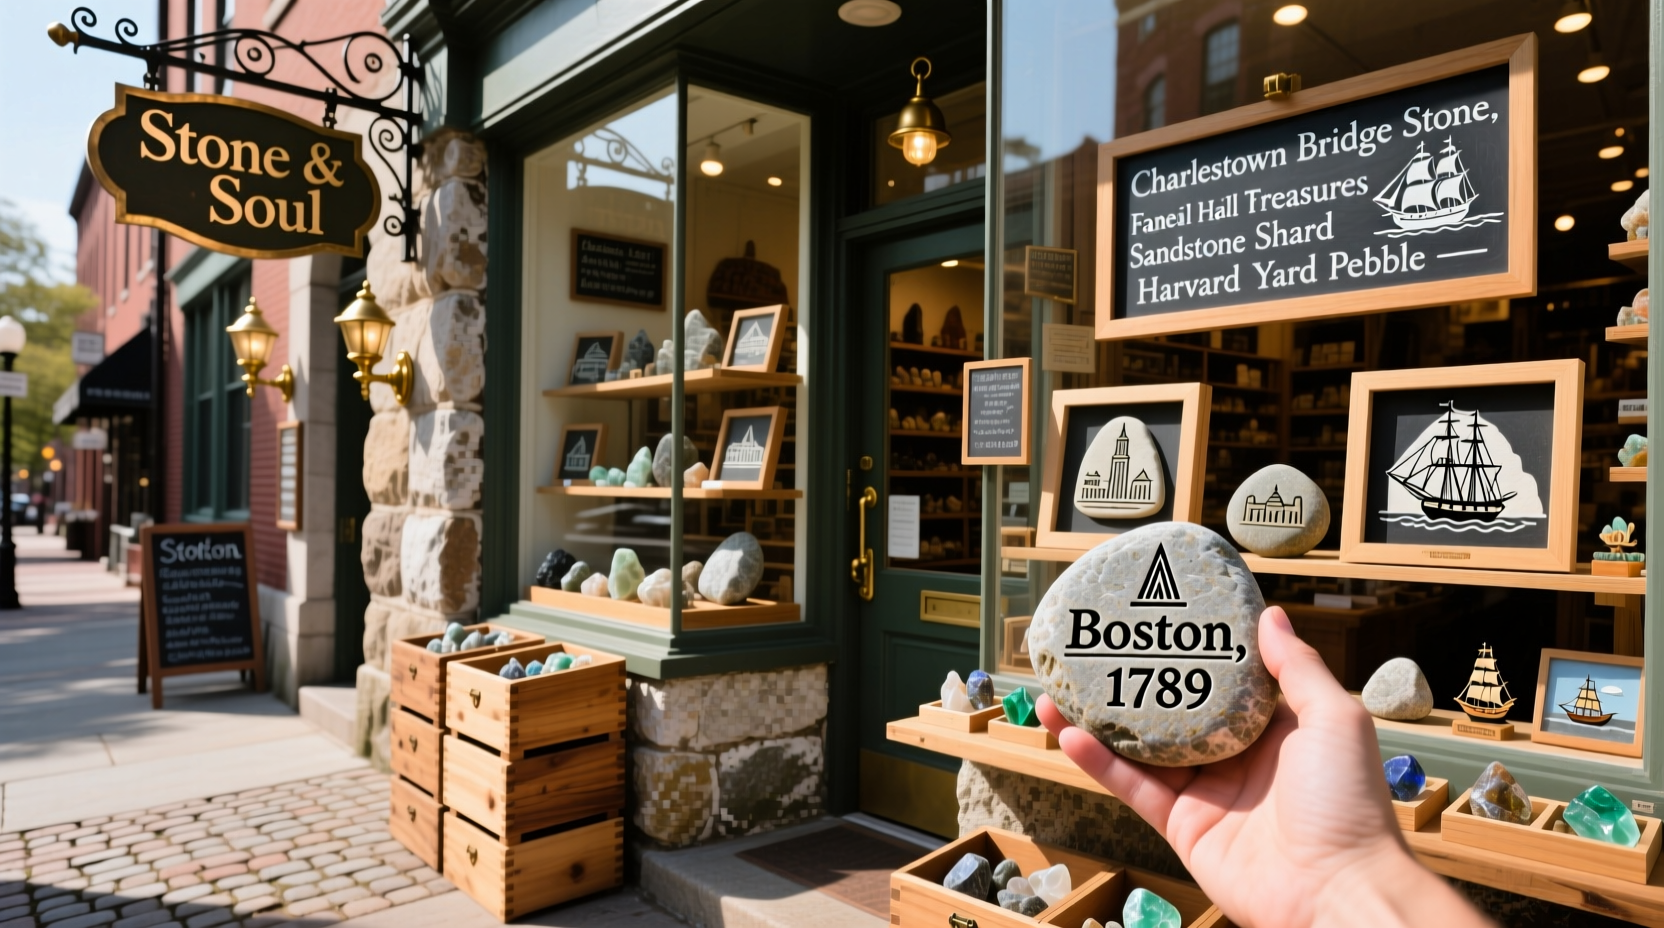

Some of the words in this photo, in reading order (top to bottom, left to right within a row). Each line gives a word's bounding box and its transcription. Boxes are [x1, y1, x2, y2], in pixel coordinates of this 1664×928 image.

[140, 108, 290, 178] Stone
[303, 142, 344, 187] &
[1130, 147, 1287, 199] Charlestown
[1297, 119, 1393, 163] Bridge
[1402, 100, 1499, 138] Stone,
[209, 174, 324, 235] Soul
[1130, 202, 1193, 236] Faneil
[1197, 192, 1239, 224] Hall
[1243, 175, 1369, 216] Treasures
[1129, 232, 1247, 270] Sandstone
[1254, 210, 1335, 251] Shard
[1136, 263, 1242, 306] Harvard
[1252, 252, 1319, 291] Yard
[1328, 241, 1426, 282] Pebble
[1064, 607, 1248, 663] Boston,
[1106, 667, 1213, 710] 1789
